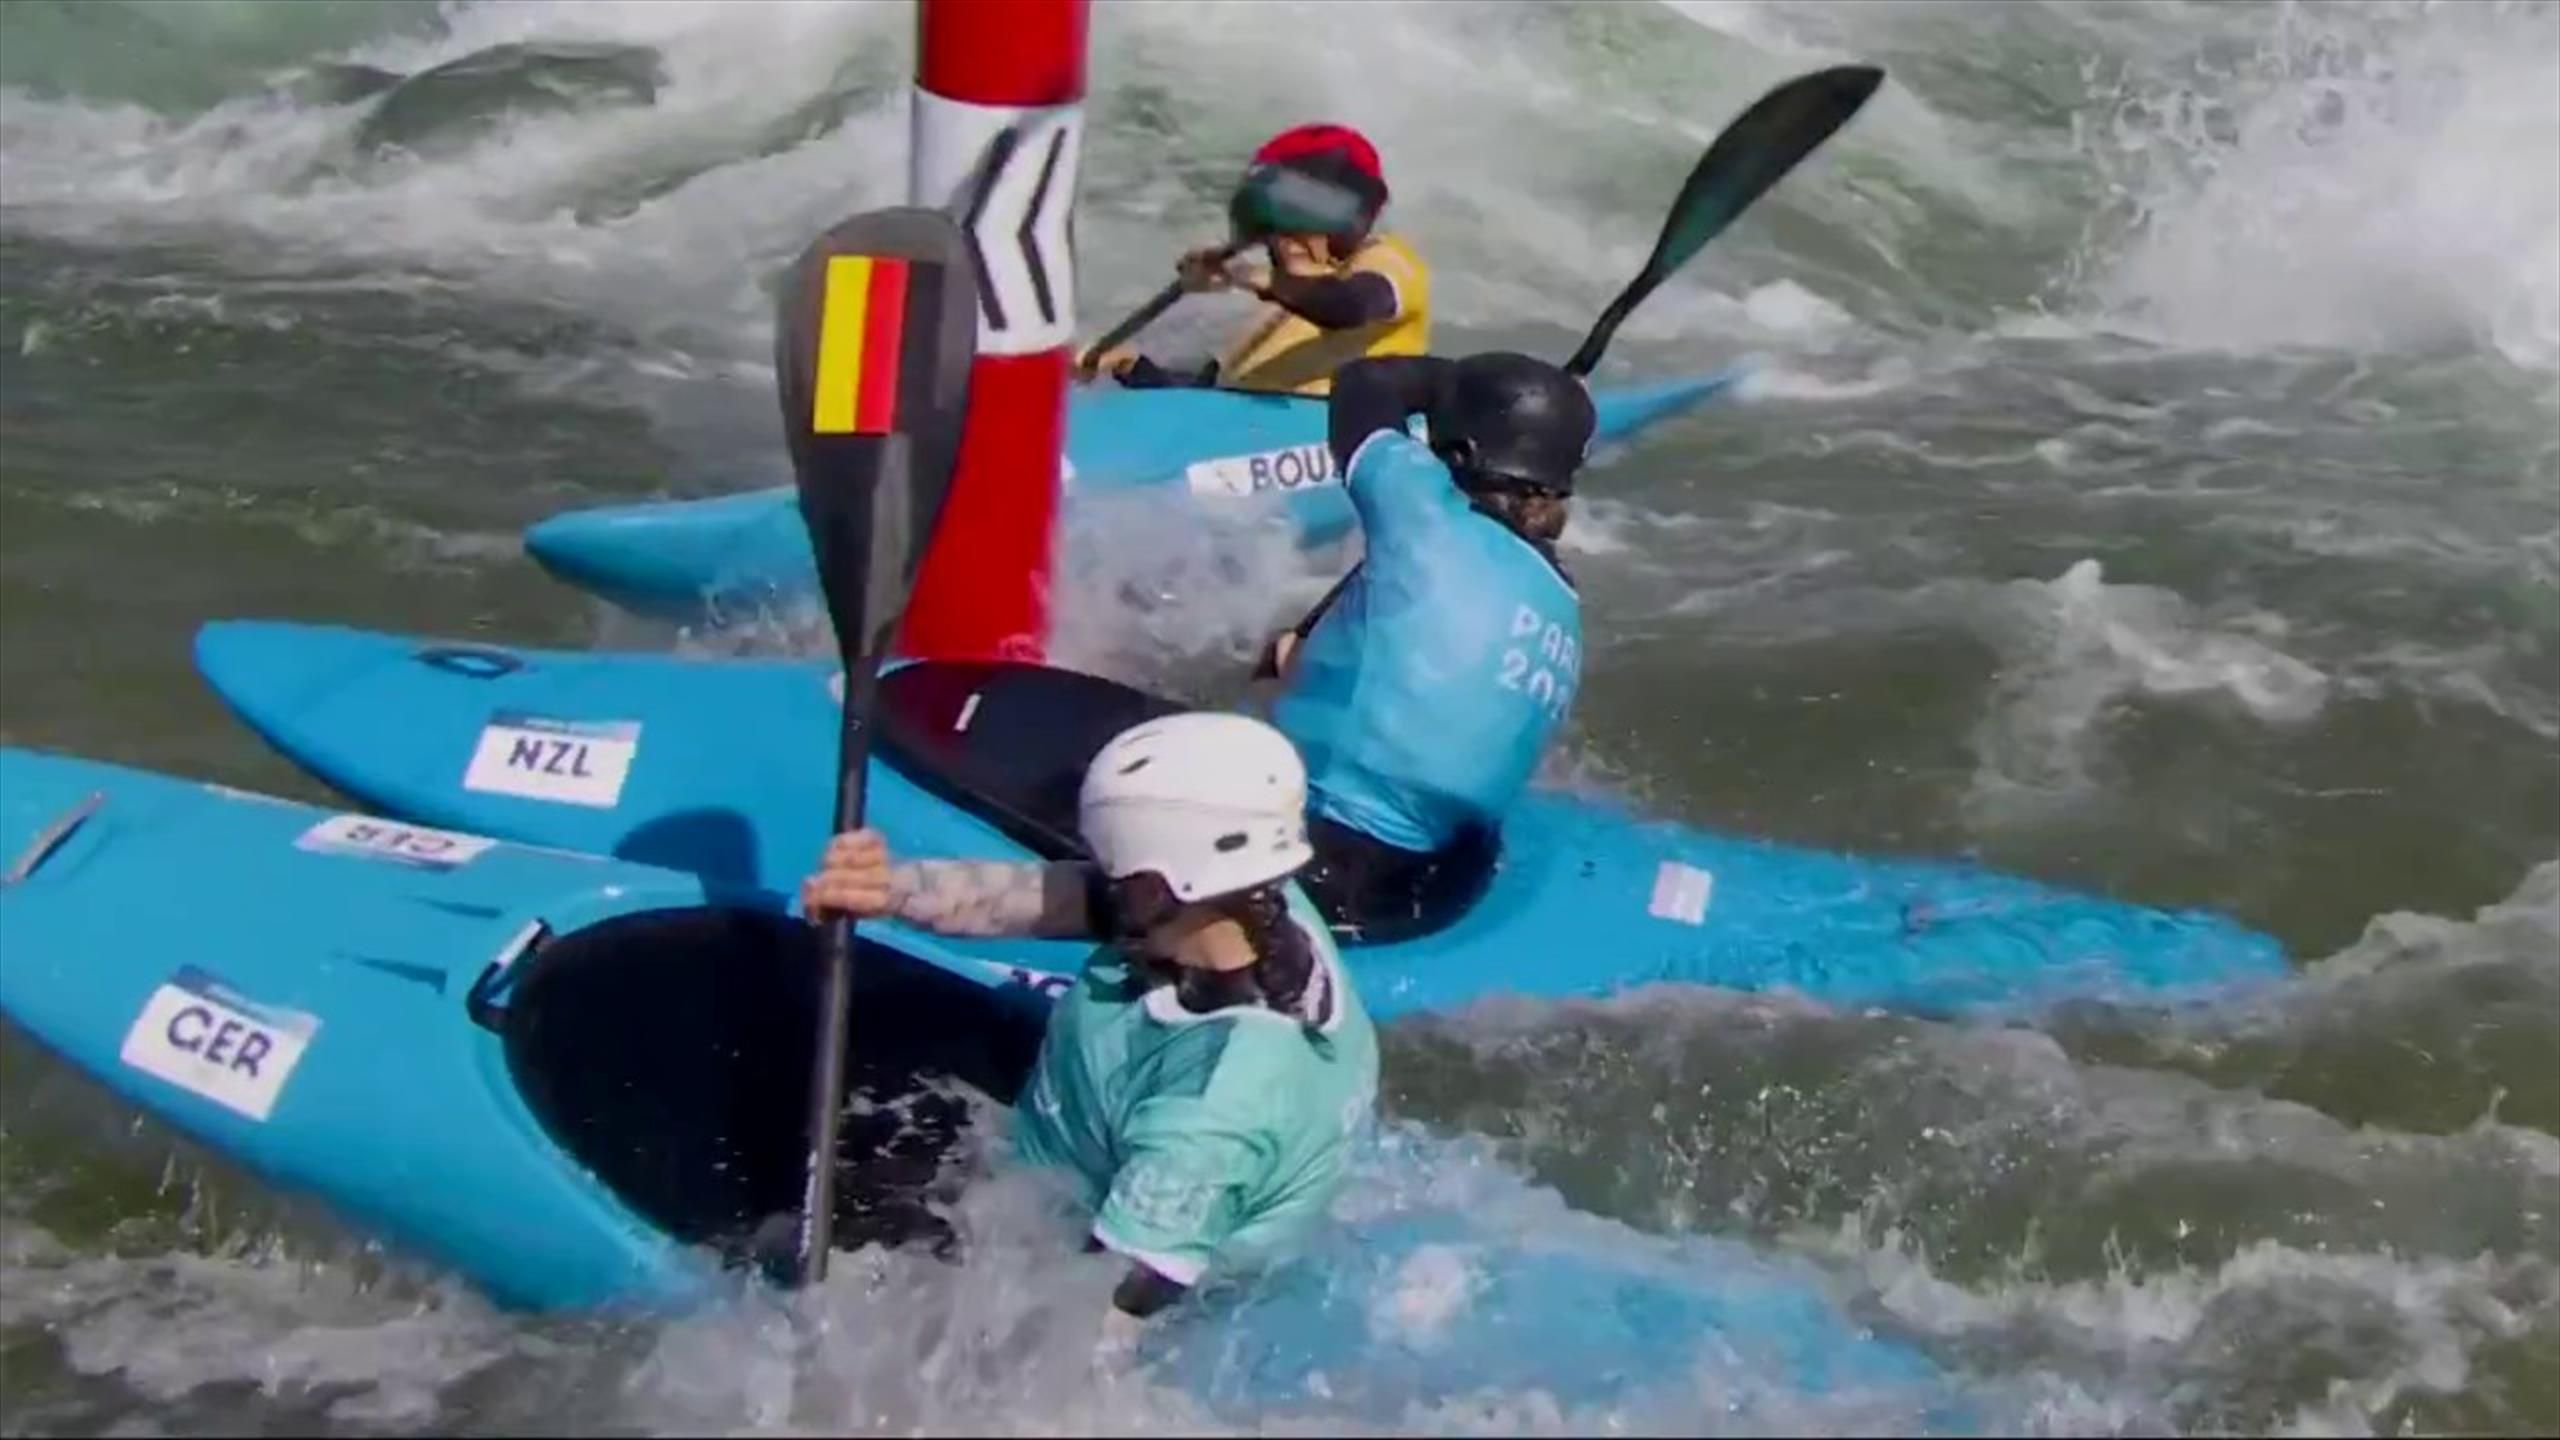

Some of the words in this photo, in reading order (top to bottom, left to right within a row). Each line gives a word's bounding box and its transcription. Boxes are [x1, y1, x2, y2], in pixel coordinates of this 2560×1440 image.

[1250, 447, 1341, 490] BOU
[1511, 603, 1575, 673] PAR
[507, 735, 593, 777] NZL
[167, 1005, 273, 1078] GER
